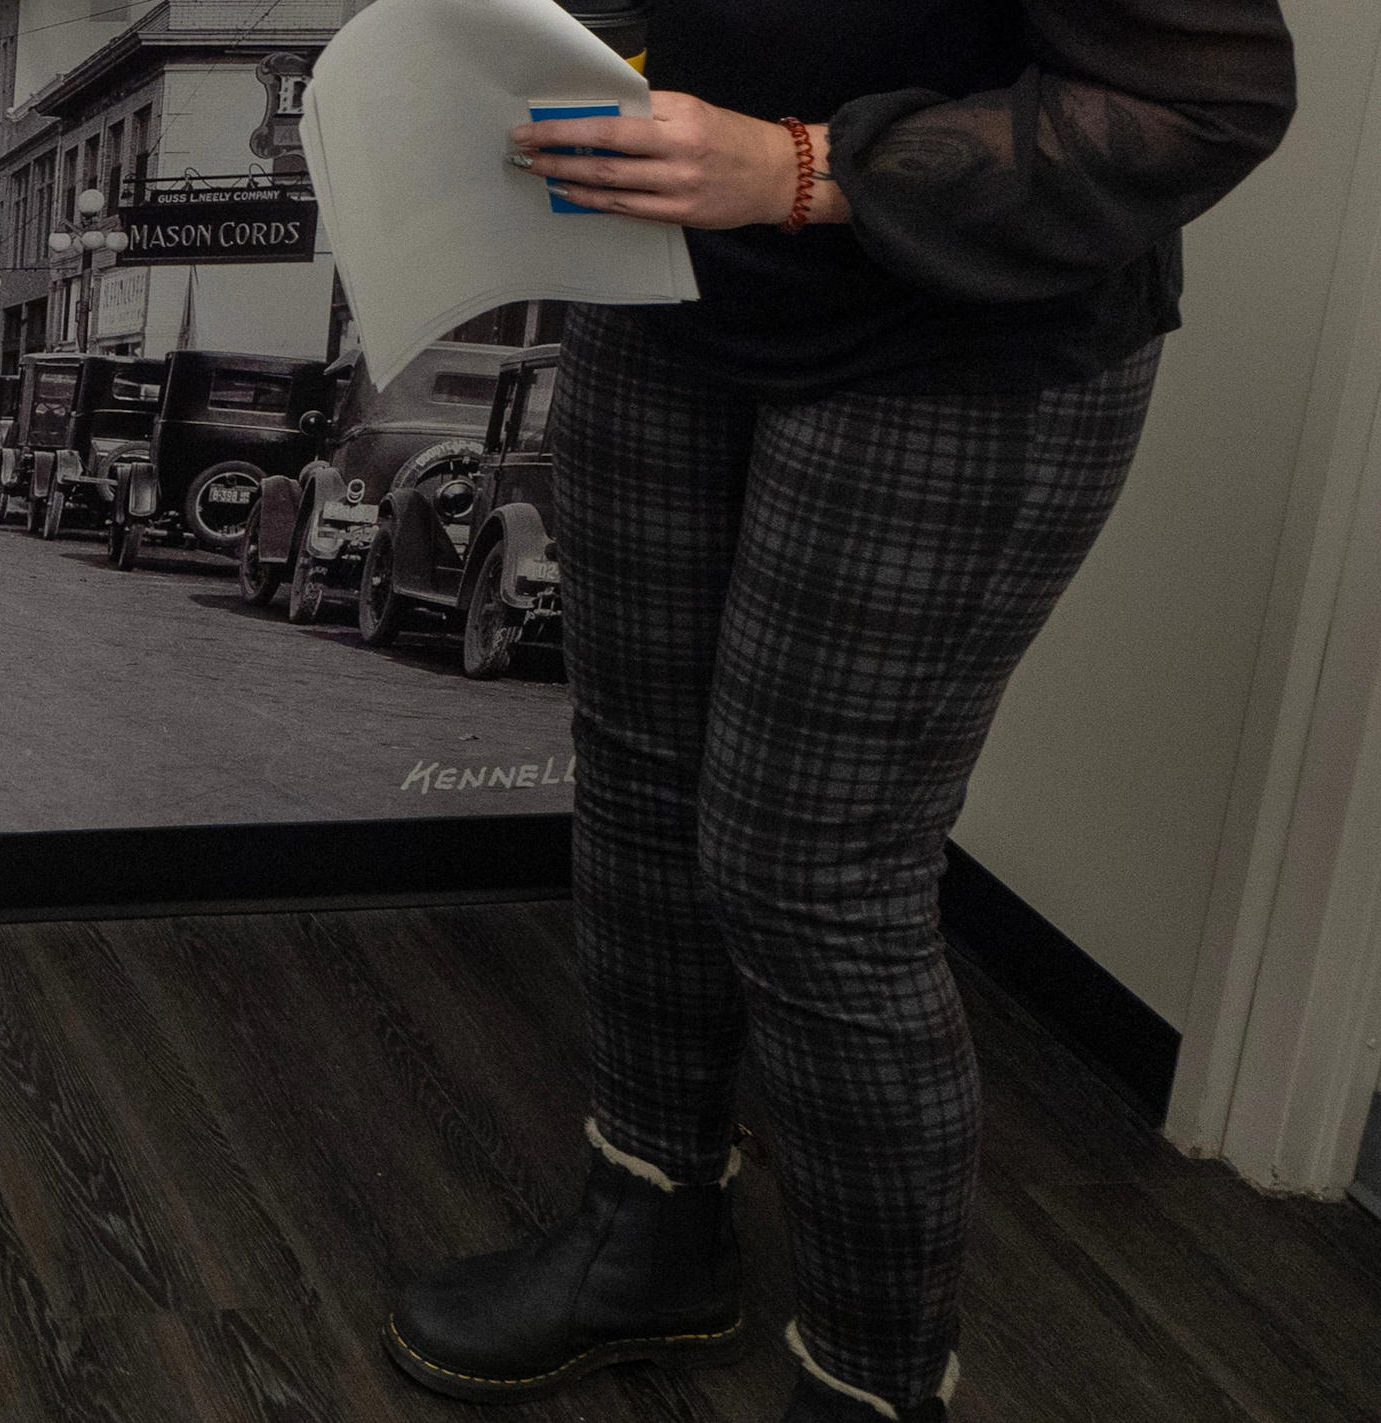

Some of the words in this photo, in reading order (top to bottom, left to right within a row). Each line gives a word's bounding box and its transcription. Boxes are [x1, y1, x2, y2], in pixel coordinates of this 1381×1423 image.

[157, 193, 187, 204] GUSS
[233, 190, 281, 201] COMPANY
[129, 223, 212, 251] MASON
[219, 221, 301, 248] CORDS
